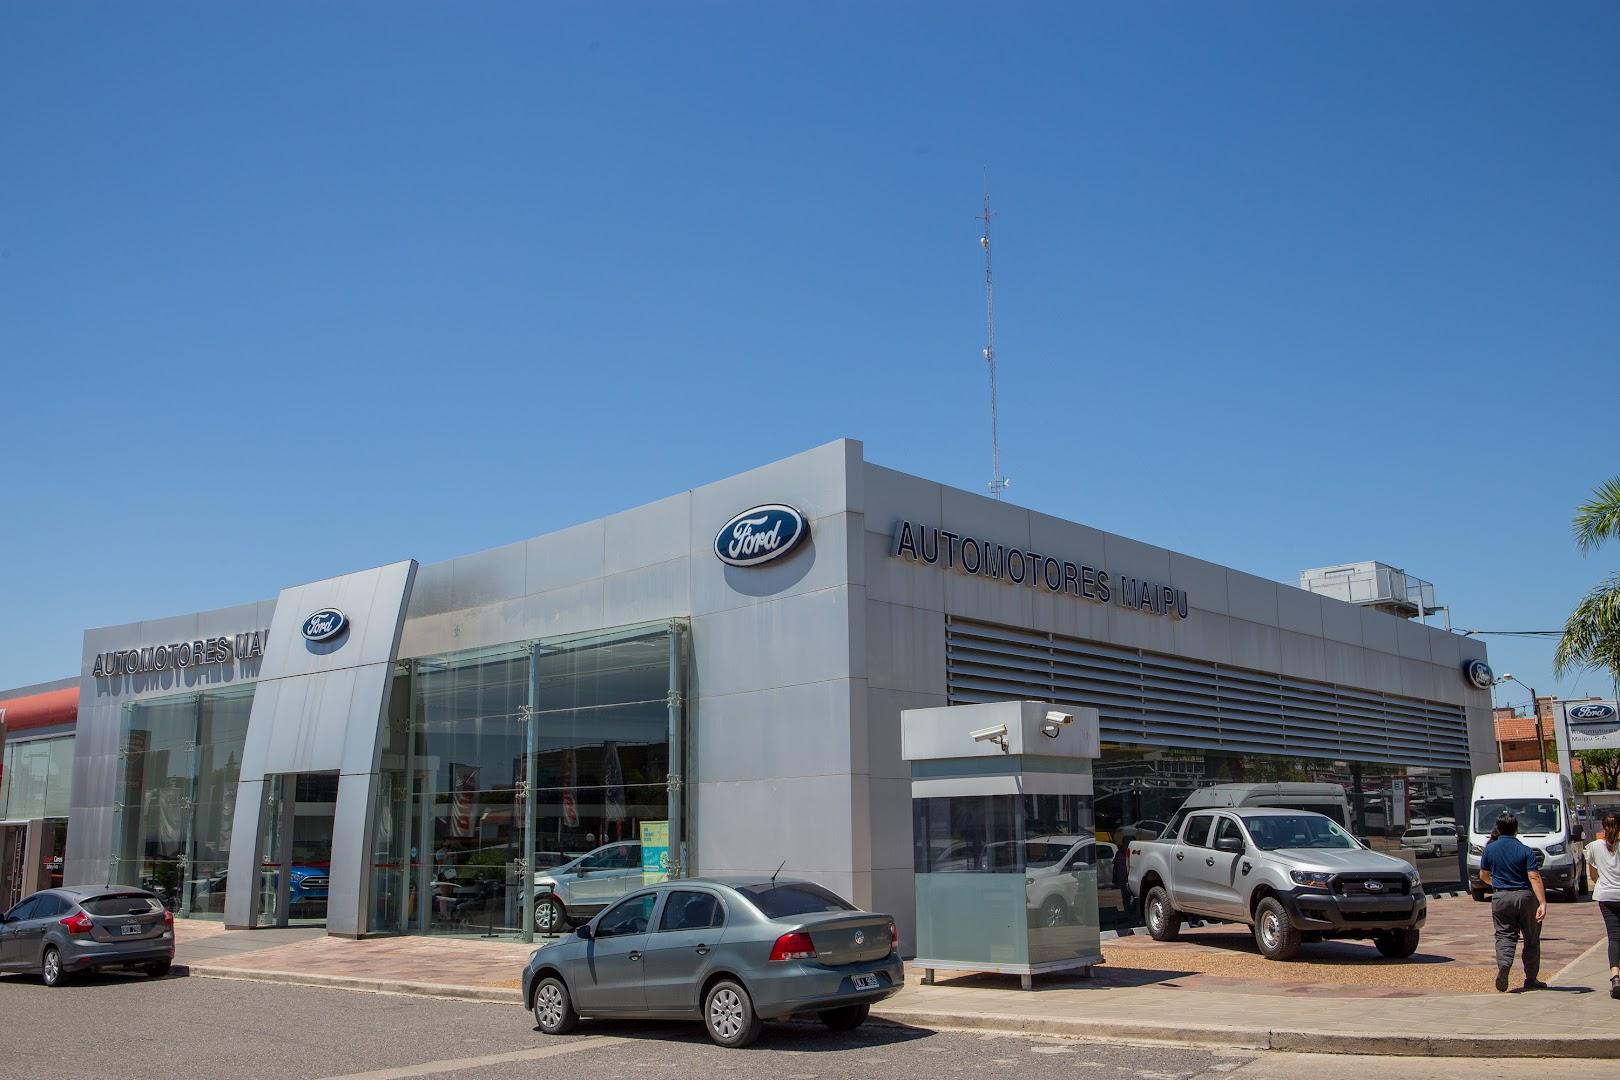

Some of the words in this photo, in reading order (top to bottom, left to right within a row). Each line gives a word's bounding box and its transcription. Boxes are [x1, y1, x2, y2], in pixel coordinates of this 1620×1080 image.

[728, 515, 782, 559] Ford
[896, 519, 1111, 604] AUTOMOTORES
[1121, 574, 1189, 620] MAIPU
[306, 613, 335, 635] Ford
[92, 636, 228, 678] AUTOMOTORES
[1577, 705, 1605, 717] Ford
